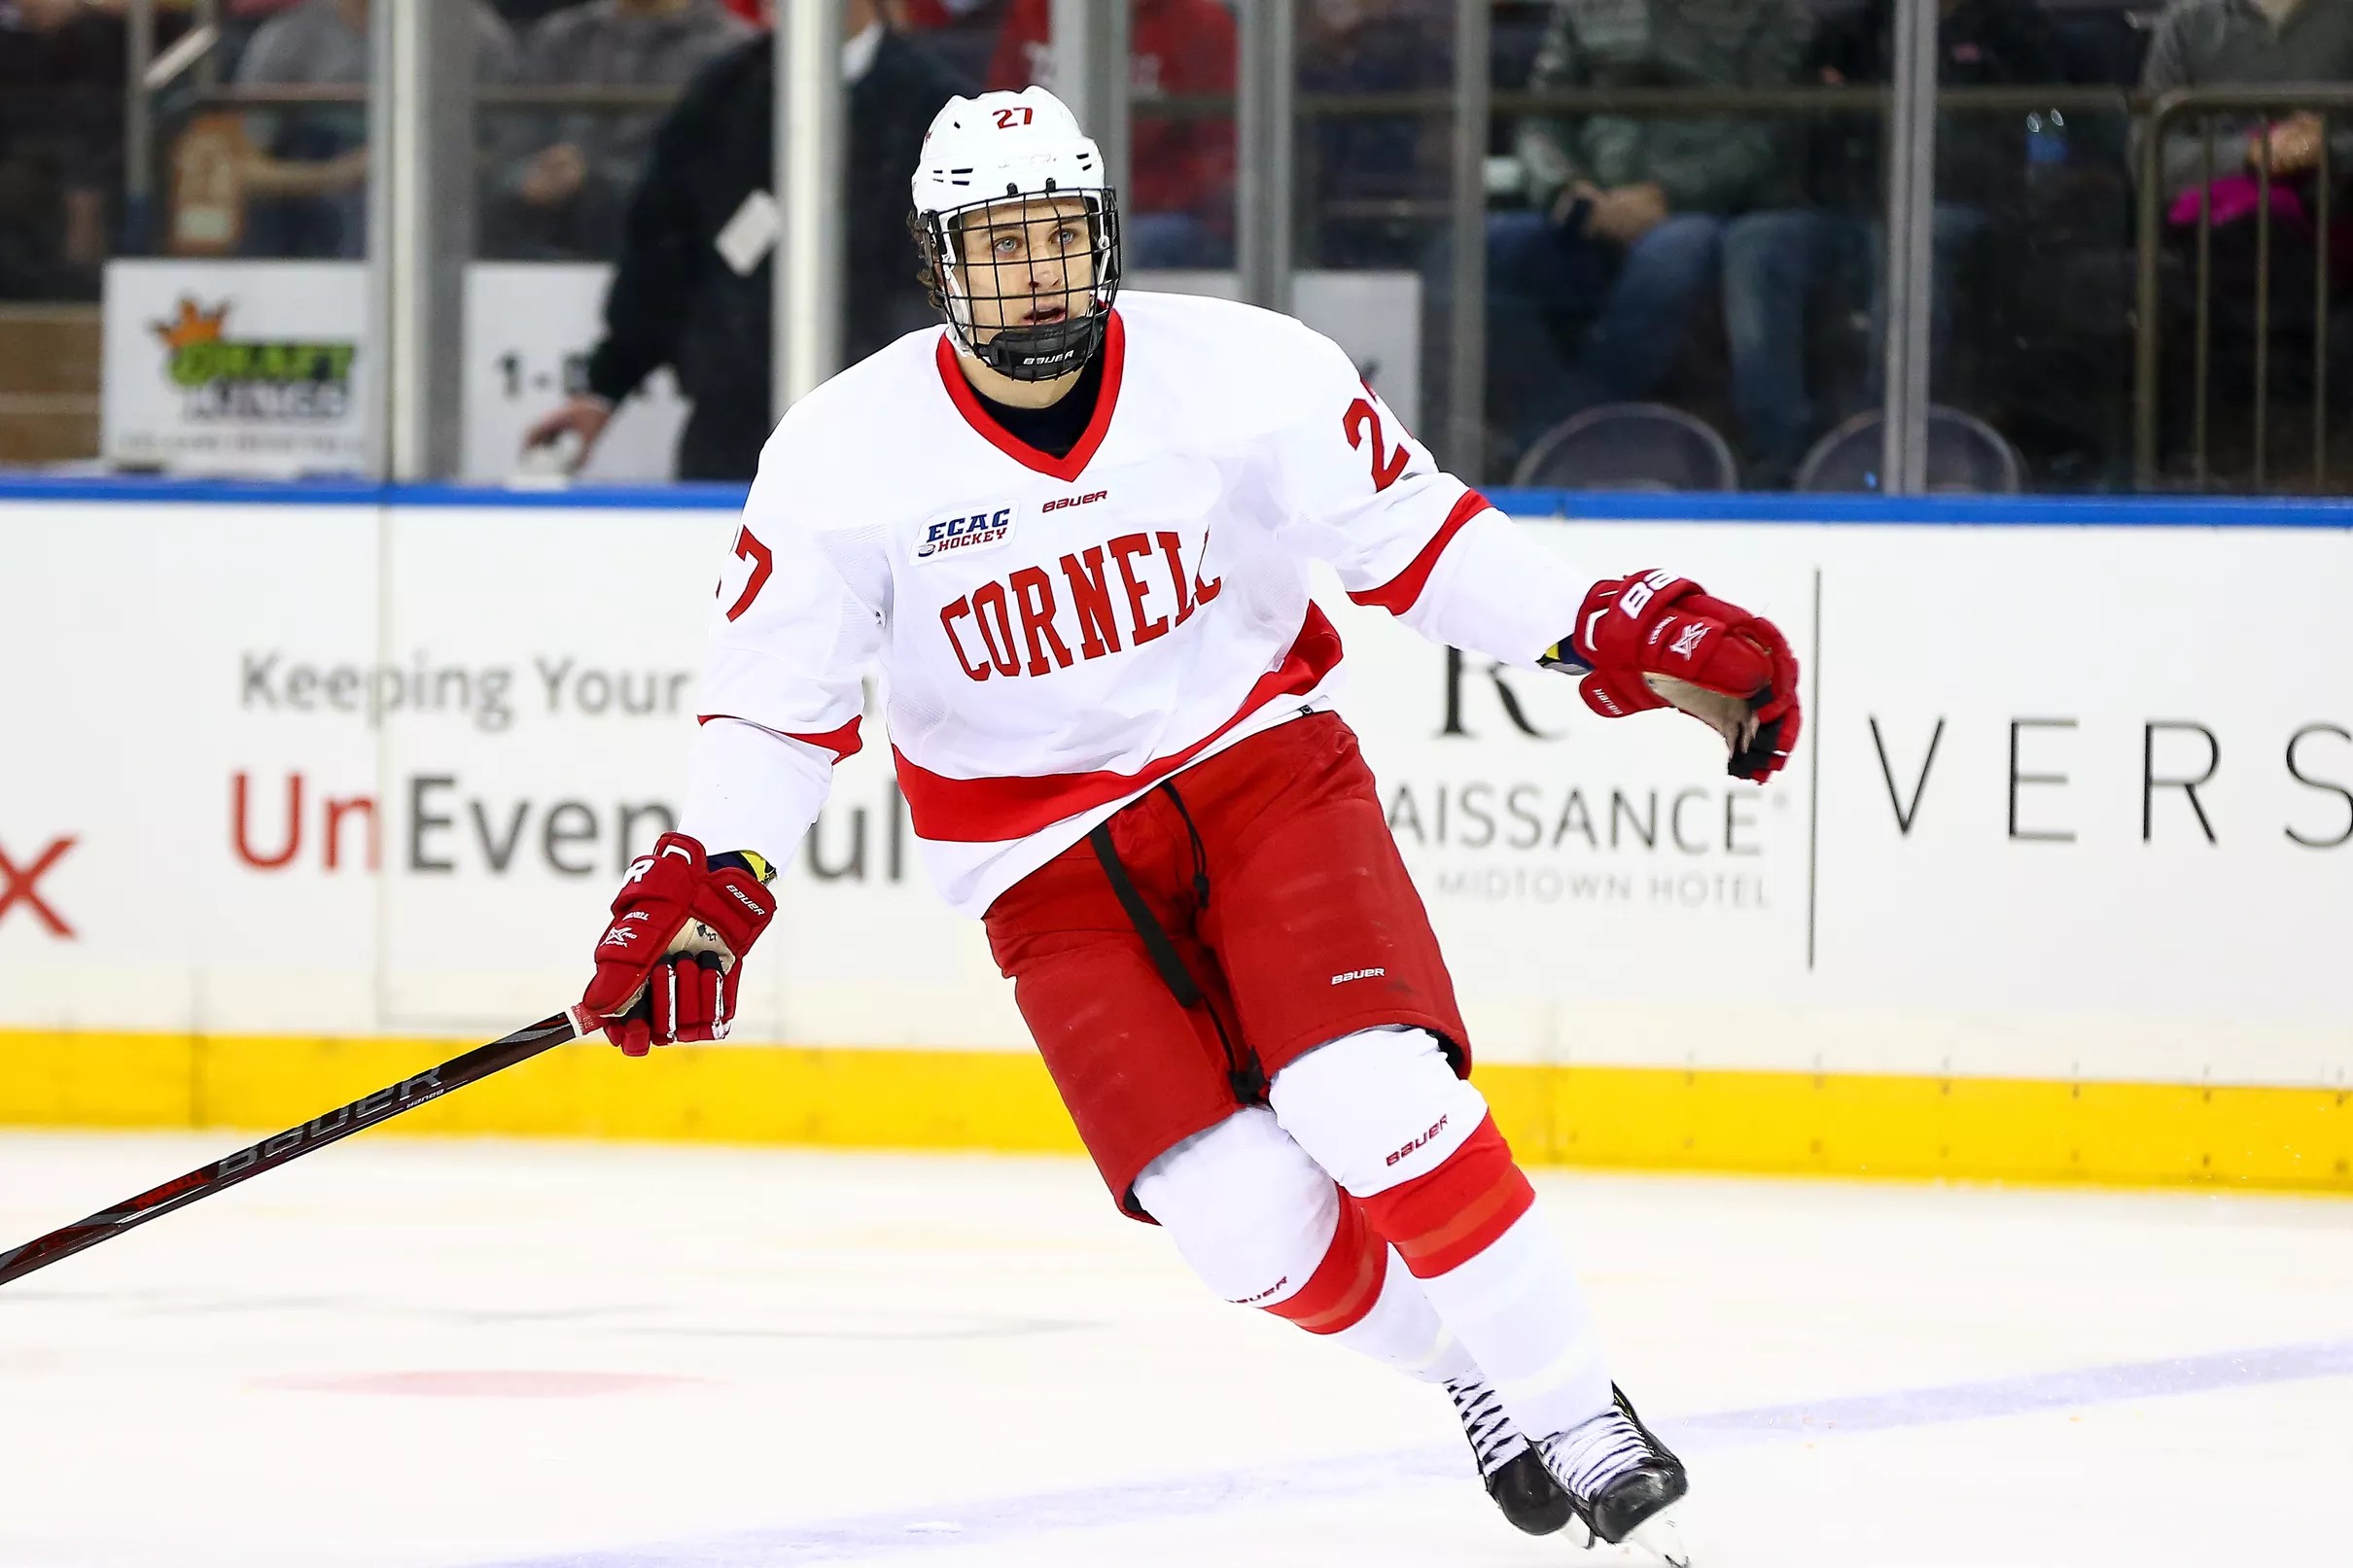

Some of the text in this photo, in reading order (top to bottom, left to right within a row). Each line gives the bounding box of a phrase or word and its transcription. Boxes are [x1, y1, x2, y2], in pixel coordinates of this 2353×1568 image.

[993, 107, 1033, 129] 27
[1343, 377, 1412, 493] 2
[1041, 490, 1108, 513] BAUER
[927, 508, 1010, 542] ECAC
[937, 527, 1007, 552] HOCKEY
[717, 524, 772, 623] 7
[240, 650, 692, 732] Keeping Your
[725, 885, 766, 916] BAUER
[1435, 868, 1772, 910] MIDTOWN HOTEL
[1331, 967, 1386, 985] BAUER
[1386, 1114, 1449, 1167] BAUER
[1224, 1275, 1287, 1304] AUER
